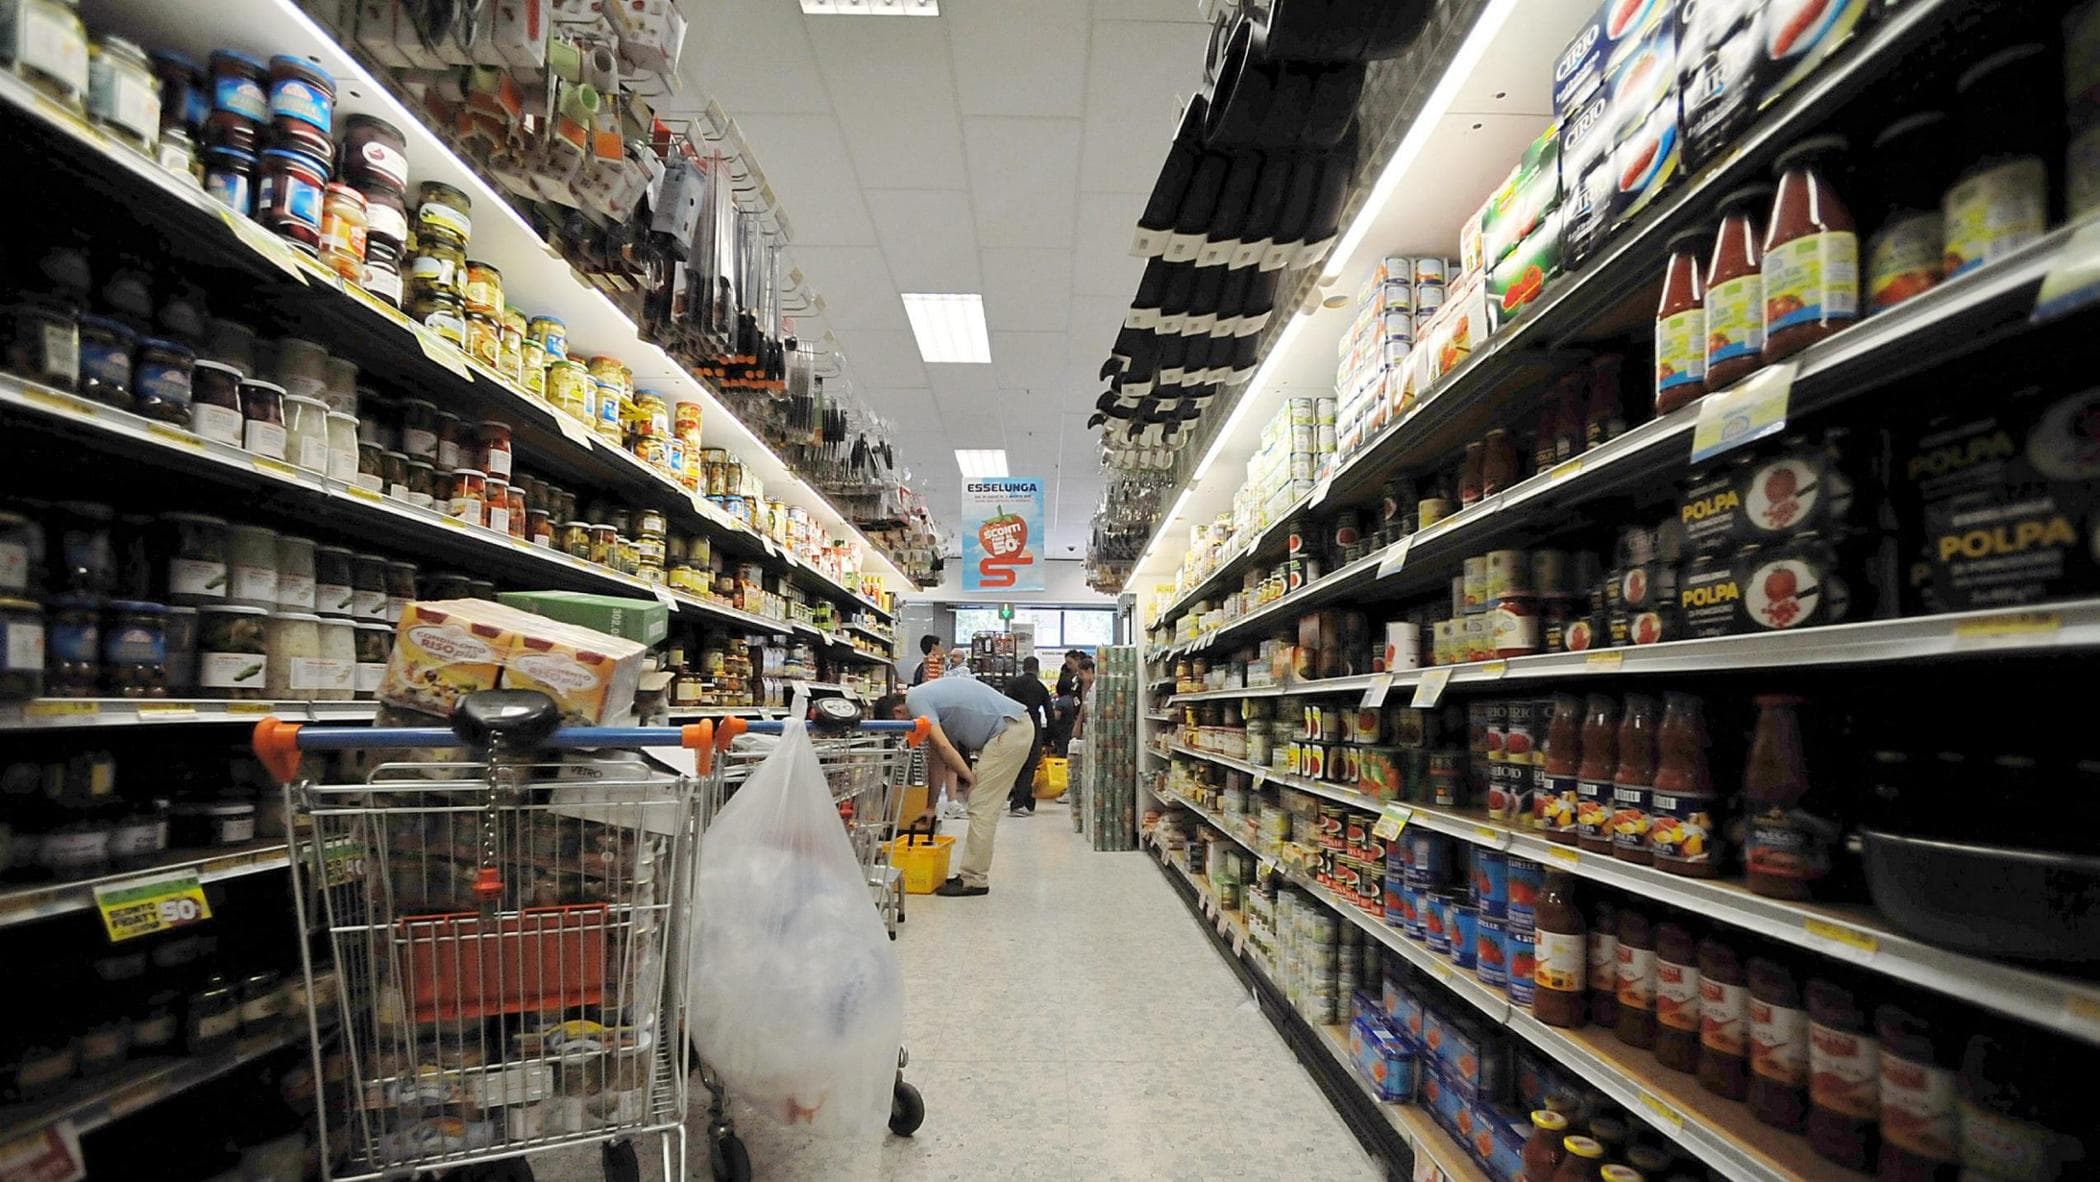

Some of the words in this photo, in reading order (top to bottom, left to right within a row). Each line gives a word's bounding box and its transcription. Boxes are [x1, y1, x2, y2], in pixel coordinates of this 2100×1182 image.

[1556, 24, 1600, 81] CIRIO
[1564, 97, 1606, 151] CIRIO
[967, 483, 1037, 493] ESSELUNGA
[1681, 490, 1740, 524] POLPA
[983, 523, 1022, 539] SCONTI
[1939, 517, 2077, 563] POLPA
[1681, 581, 1740, 609] POLPA
[421, 638, 455, 654] RISO
[570, 766, 603, 778] VETRO
